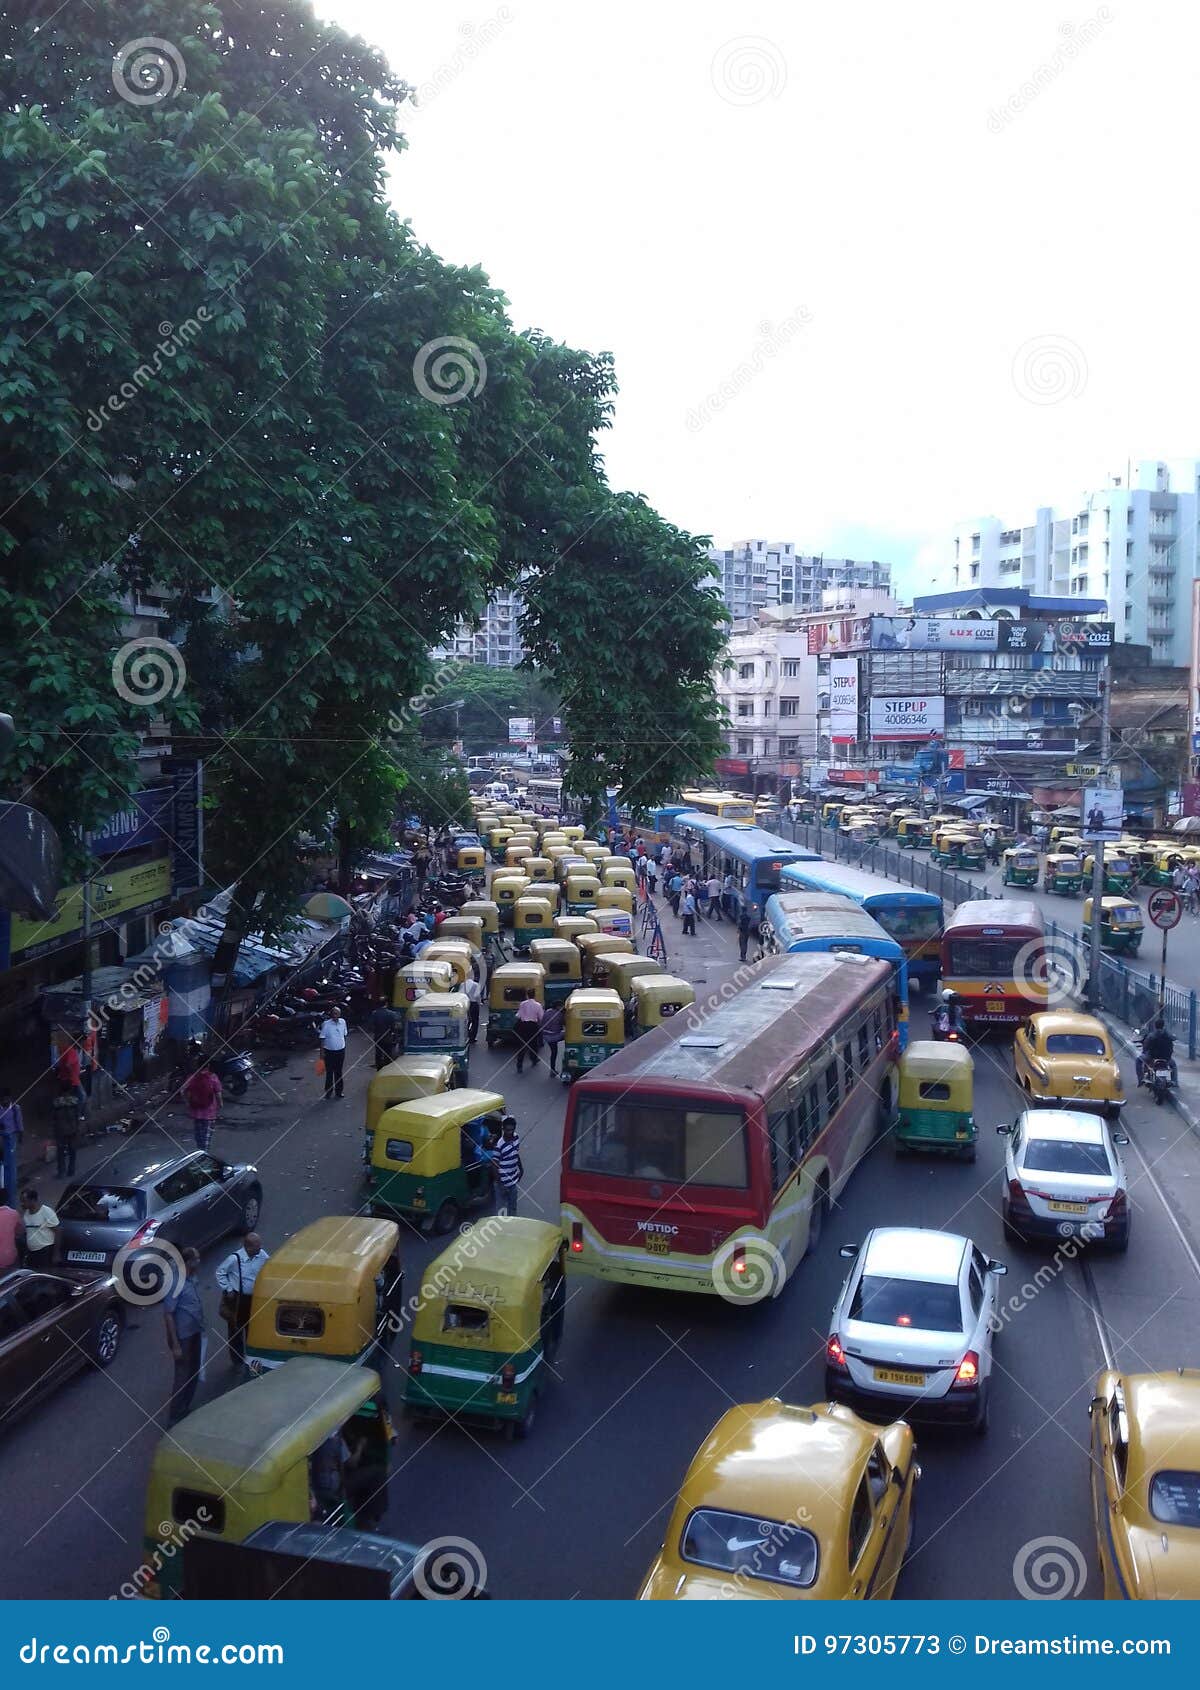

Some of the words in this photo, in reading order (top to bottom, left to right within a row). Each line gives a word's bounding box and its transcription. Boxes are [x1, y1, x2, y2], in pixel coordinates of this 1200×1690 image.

[949, 629, 973, 637] LUX
[833, 676, 856, 688] STEPUP
[885, 701, 927, 712] STEPUP
[885, 713, 927, 724] 40086346
[1072, 764, 1096, 776] Nikon
[637, 1221, 679, 1235] WBTIDC
